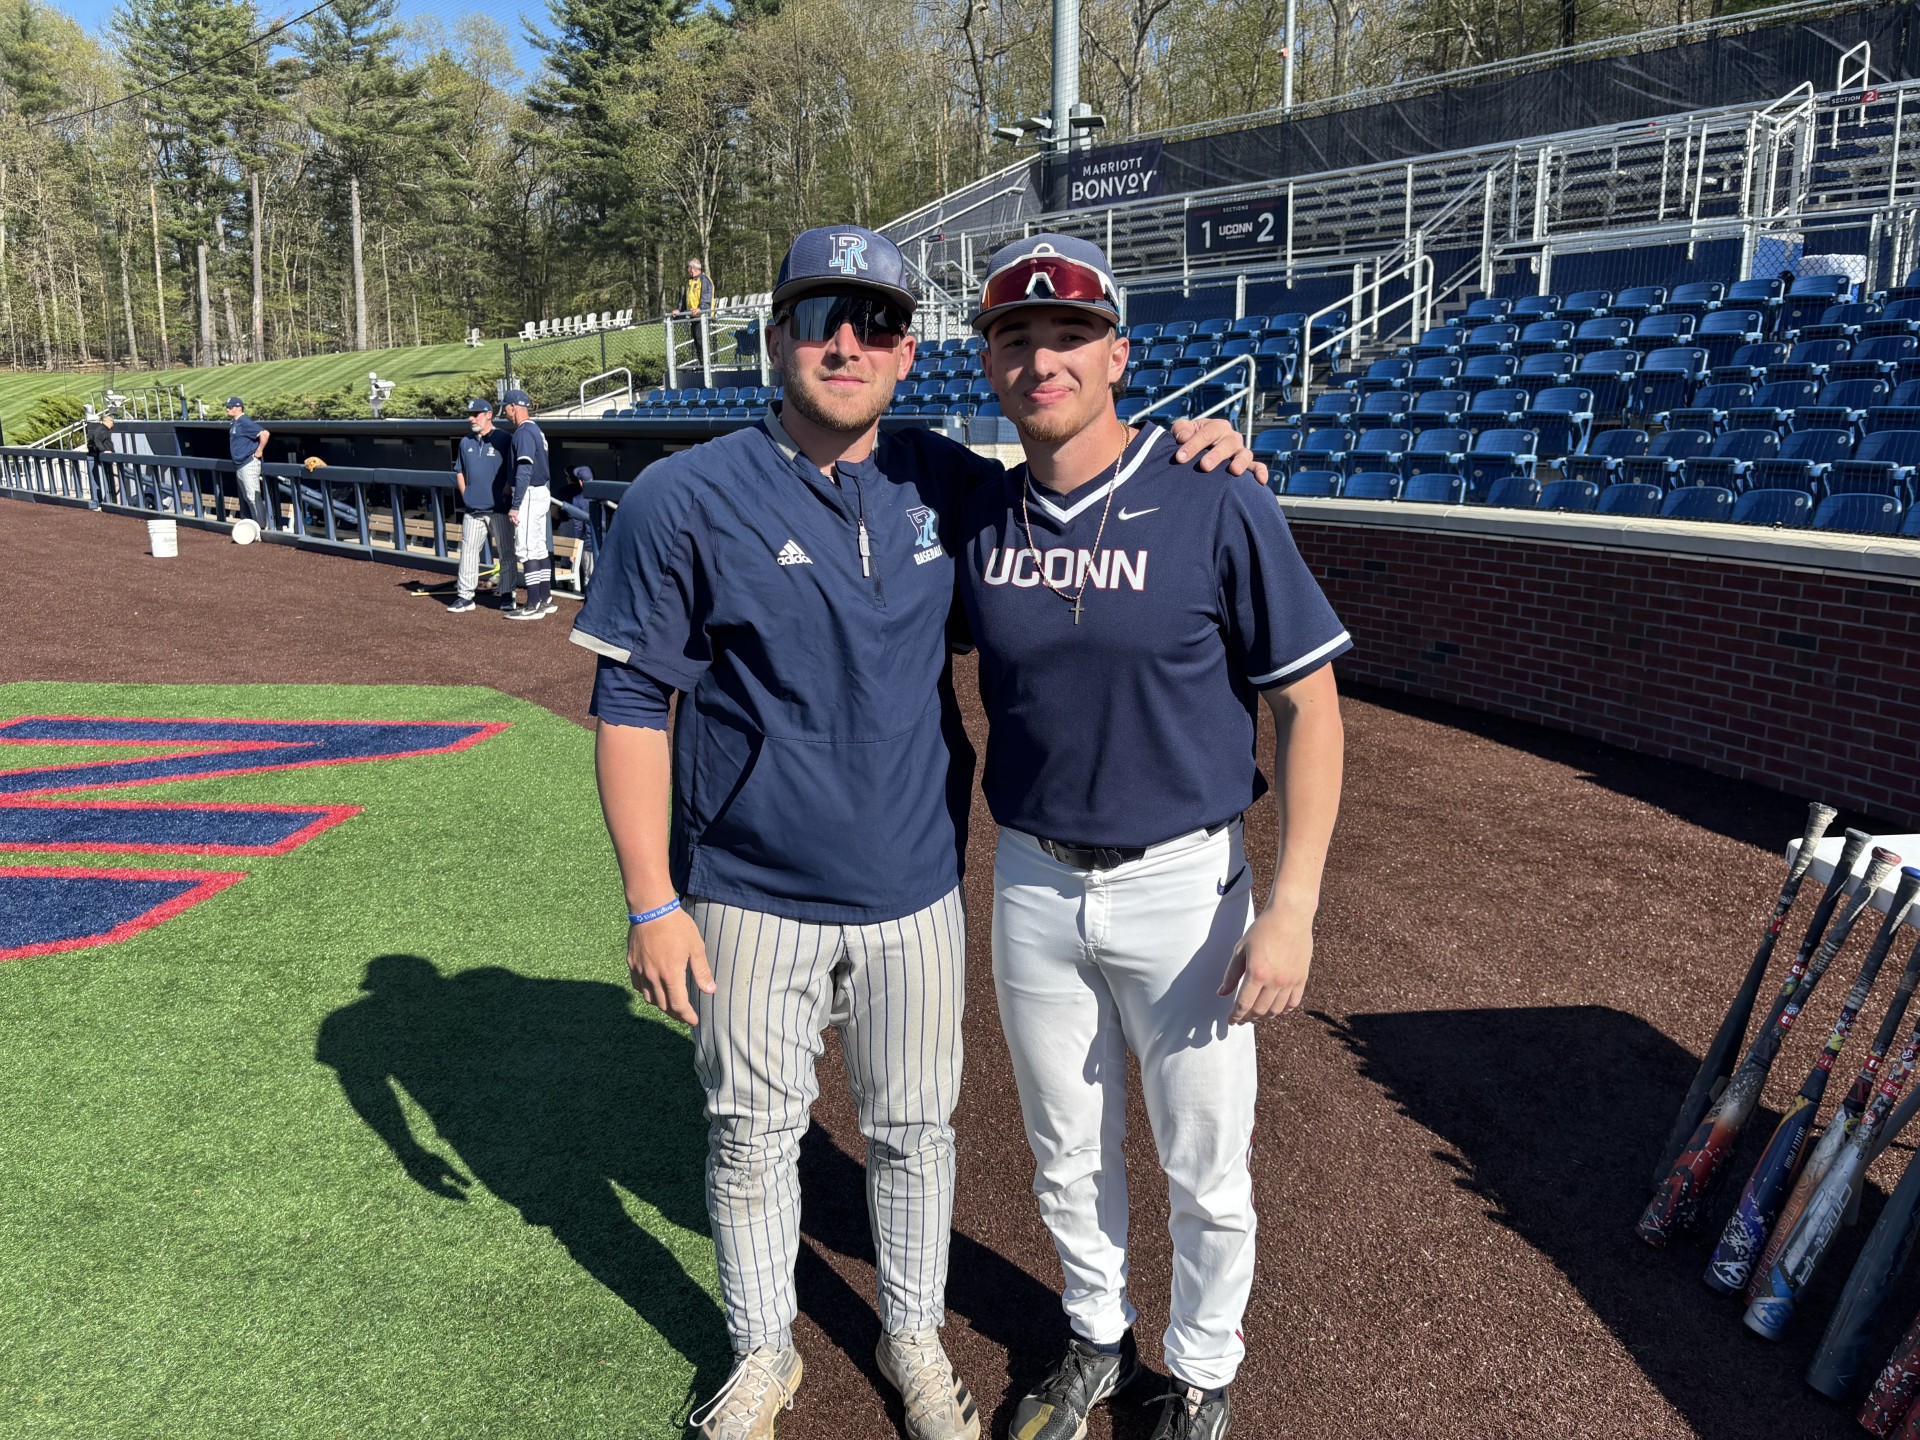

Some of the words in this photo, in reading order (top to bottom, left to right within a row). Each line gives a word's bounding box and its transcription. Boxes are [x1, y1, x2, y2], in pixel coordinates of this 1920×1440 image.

[1831, 95, 1861, 105] SECTION
[1866, 91, 1875, 102] 2
[1083, 156, 1143, 177] MARRIOTT
[1072, 170, 1153, 201] BONVOY
[1222, 204, 1249, 213] SECTIONS
[1201, 220, 1211, 249] 1
[1218, 221, 1253, 236] UCONN
[1256, 212, 1274, 243] 2
[983, 547, 1148, 592] UCONN
